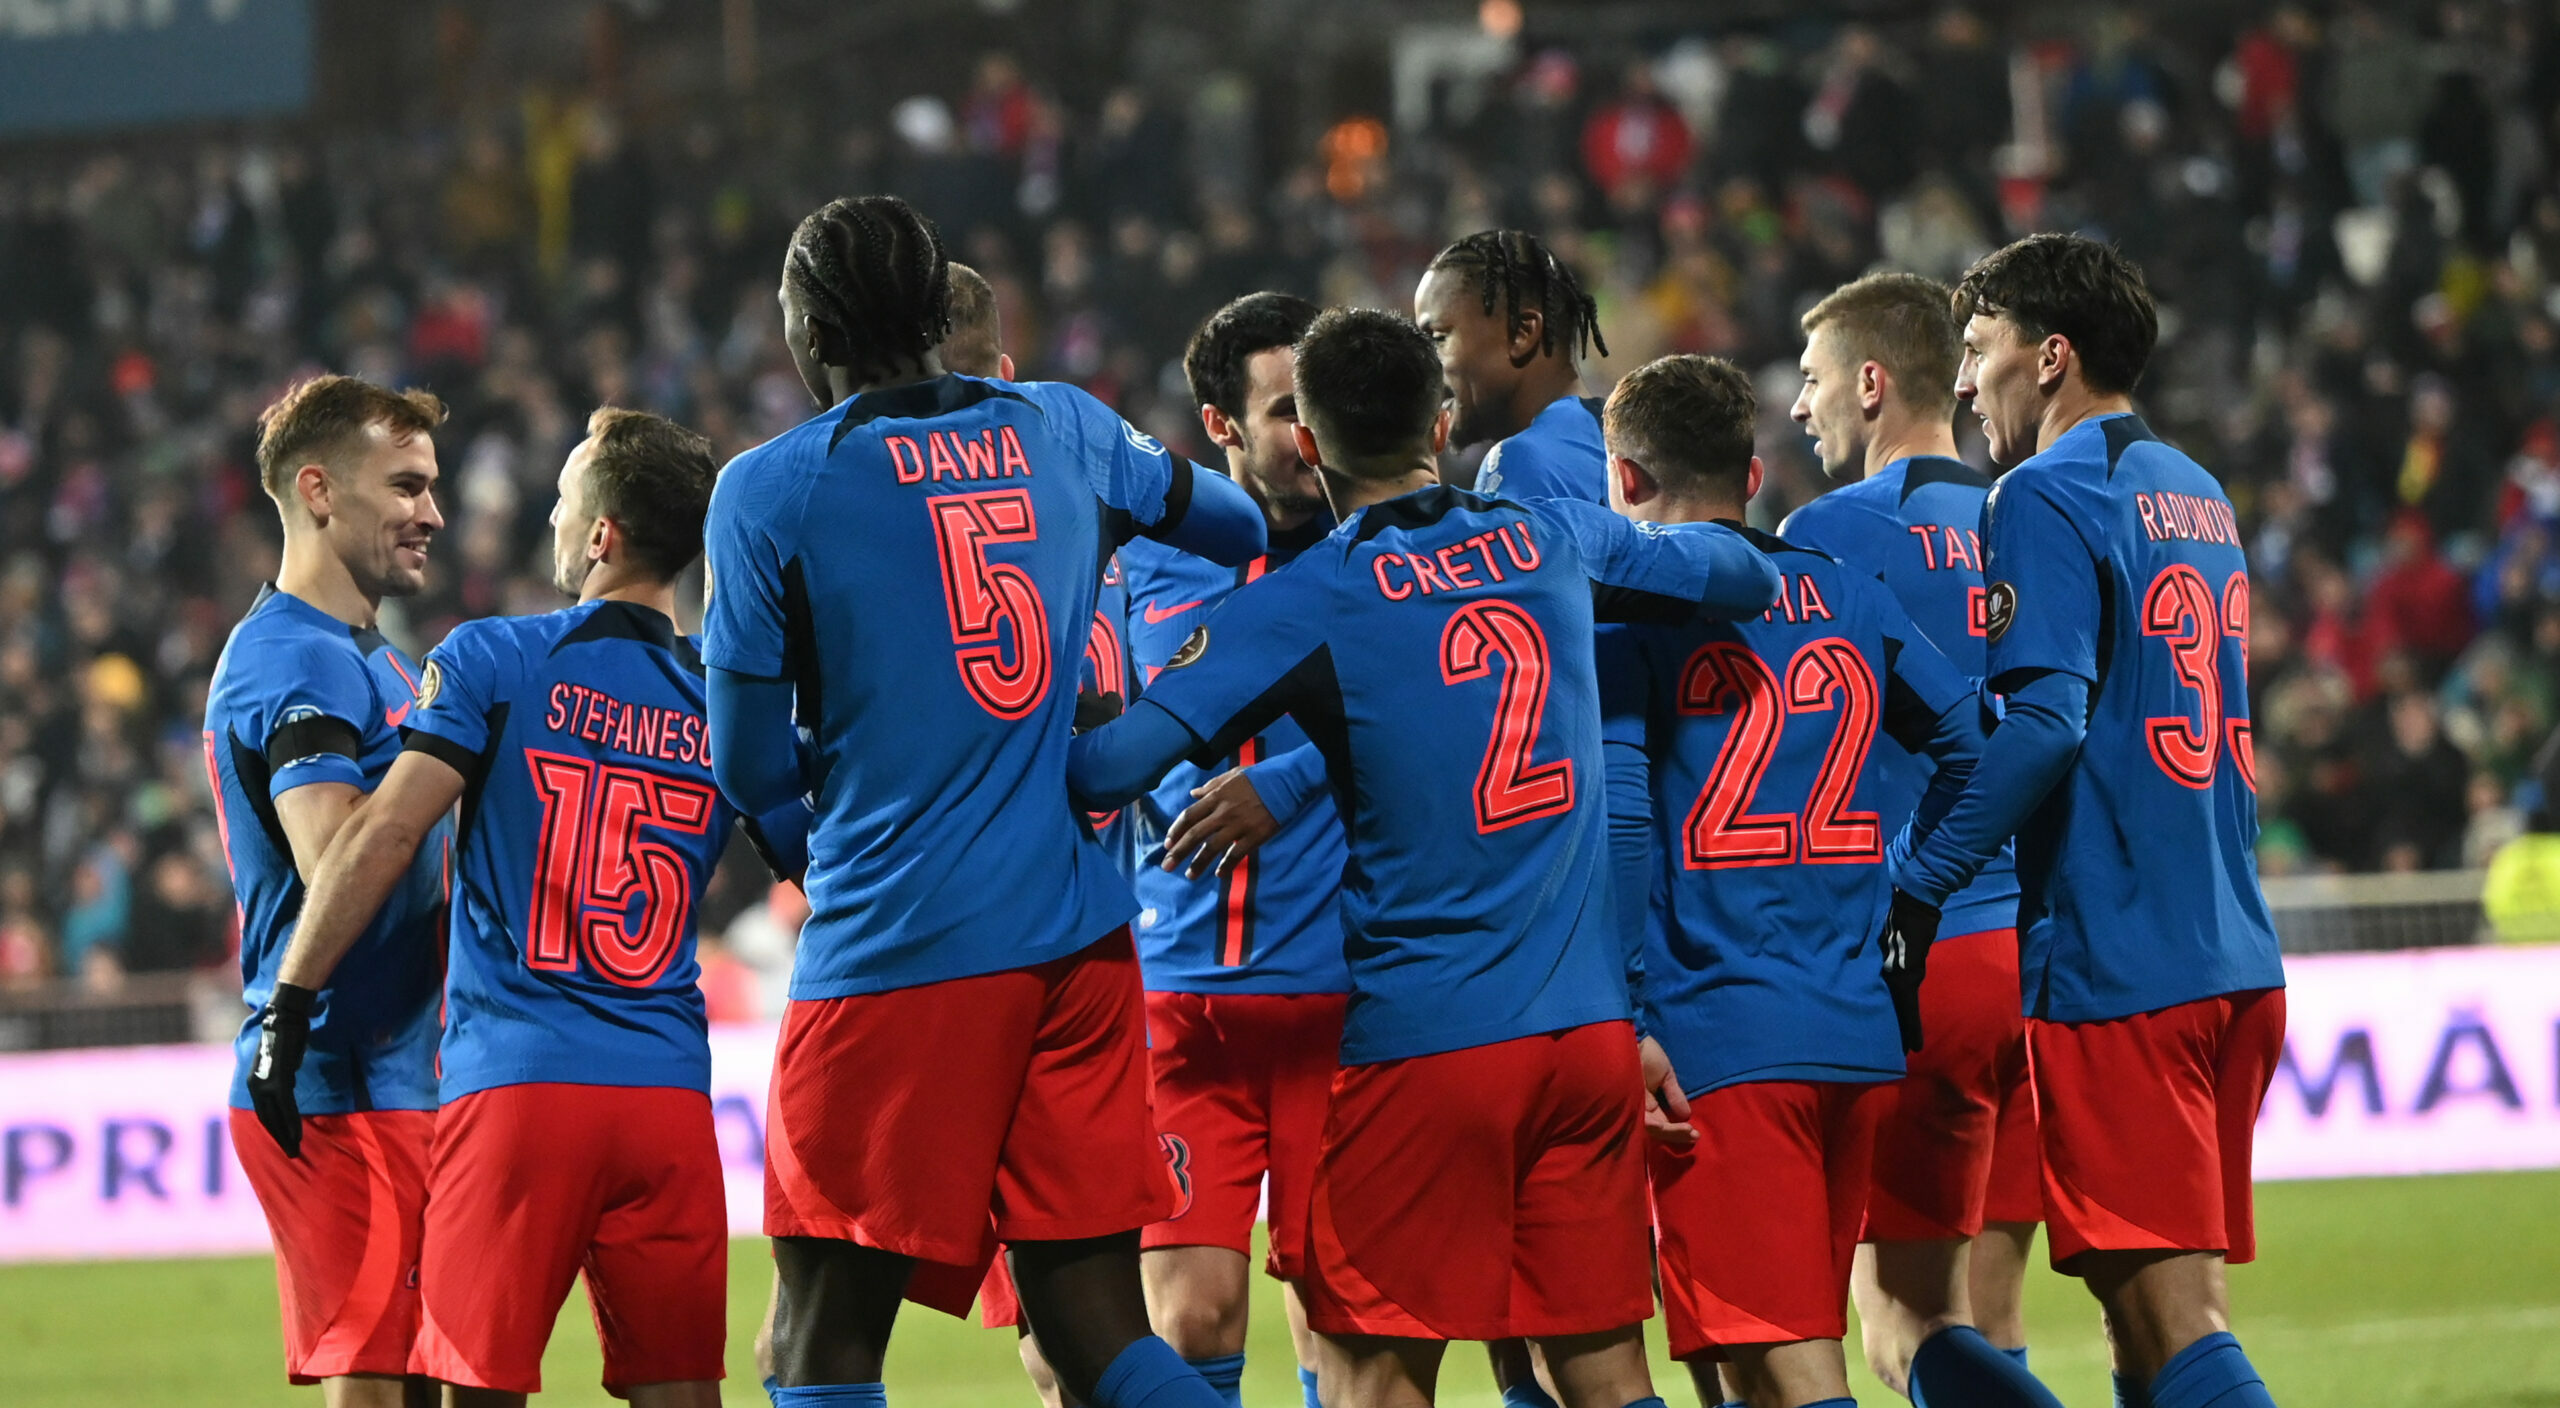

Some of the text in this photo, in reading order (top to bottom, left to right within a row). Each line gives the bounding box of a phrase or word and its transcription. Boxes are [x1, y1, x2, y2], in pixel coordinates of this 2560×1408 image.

[885, 425, 1032, 484] DAWA
[1373, 521, 1540, 600] CRETU
[926, 488, 1051, 720] 5
[1439, 598, 1574, 834] 2
[524, 748, 716, 988] 15
[1677, 637, 1883, 870] 22
